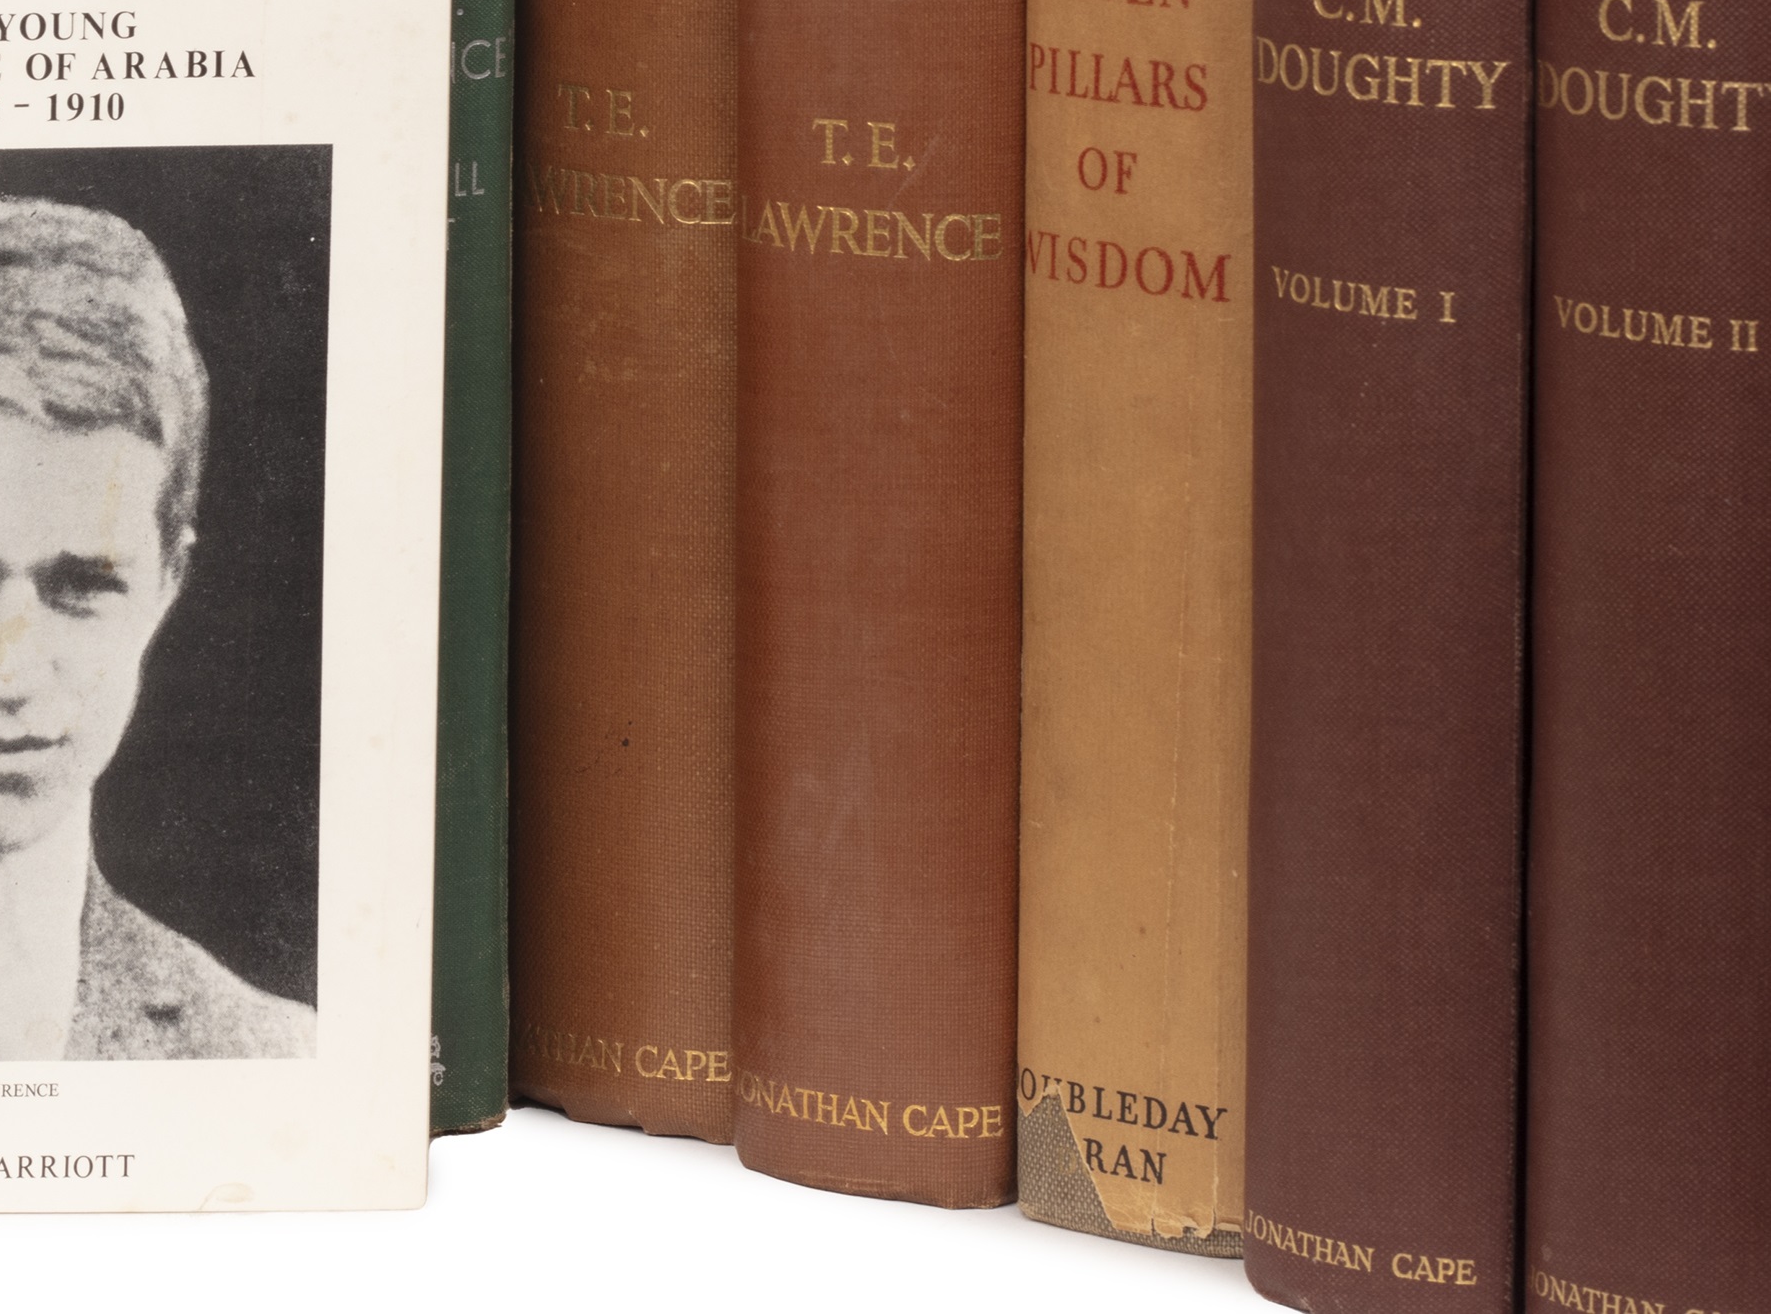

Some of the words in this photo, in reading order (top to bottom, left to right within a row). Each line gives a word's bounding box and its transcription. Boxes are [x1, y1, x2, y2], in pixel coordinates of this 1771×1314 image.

[26, 50, 76, 82] OF
[91, 49, 256, 81] ARABIA
[1029, 42, 1209, 112] PILLARS
[1257, 35, 1512, 110] DOUGHTY
[47, 92, 126, 123] 1910
[1077, 146, 1138, 195] OF
[741, 195, 1003, 261] LAWRENCE
[1271, 265, 1418, 321] VOLUME
[1438, 291, 1458, 324] I
[1553, 295, 1714, 351] VOLUME
[1729, 318, 1760, 353] II
[635, 1044, 733, 1082] CAPE
[903, 1103, 1004, 1139] CAPE
[1244, 1209, 1375, 1273] JONATHAN
[1391, 1252, 1478, 1286] CAPE
